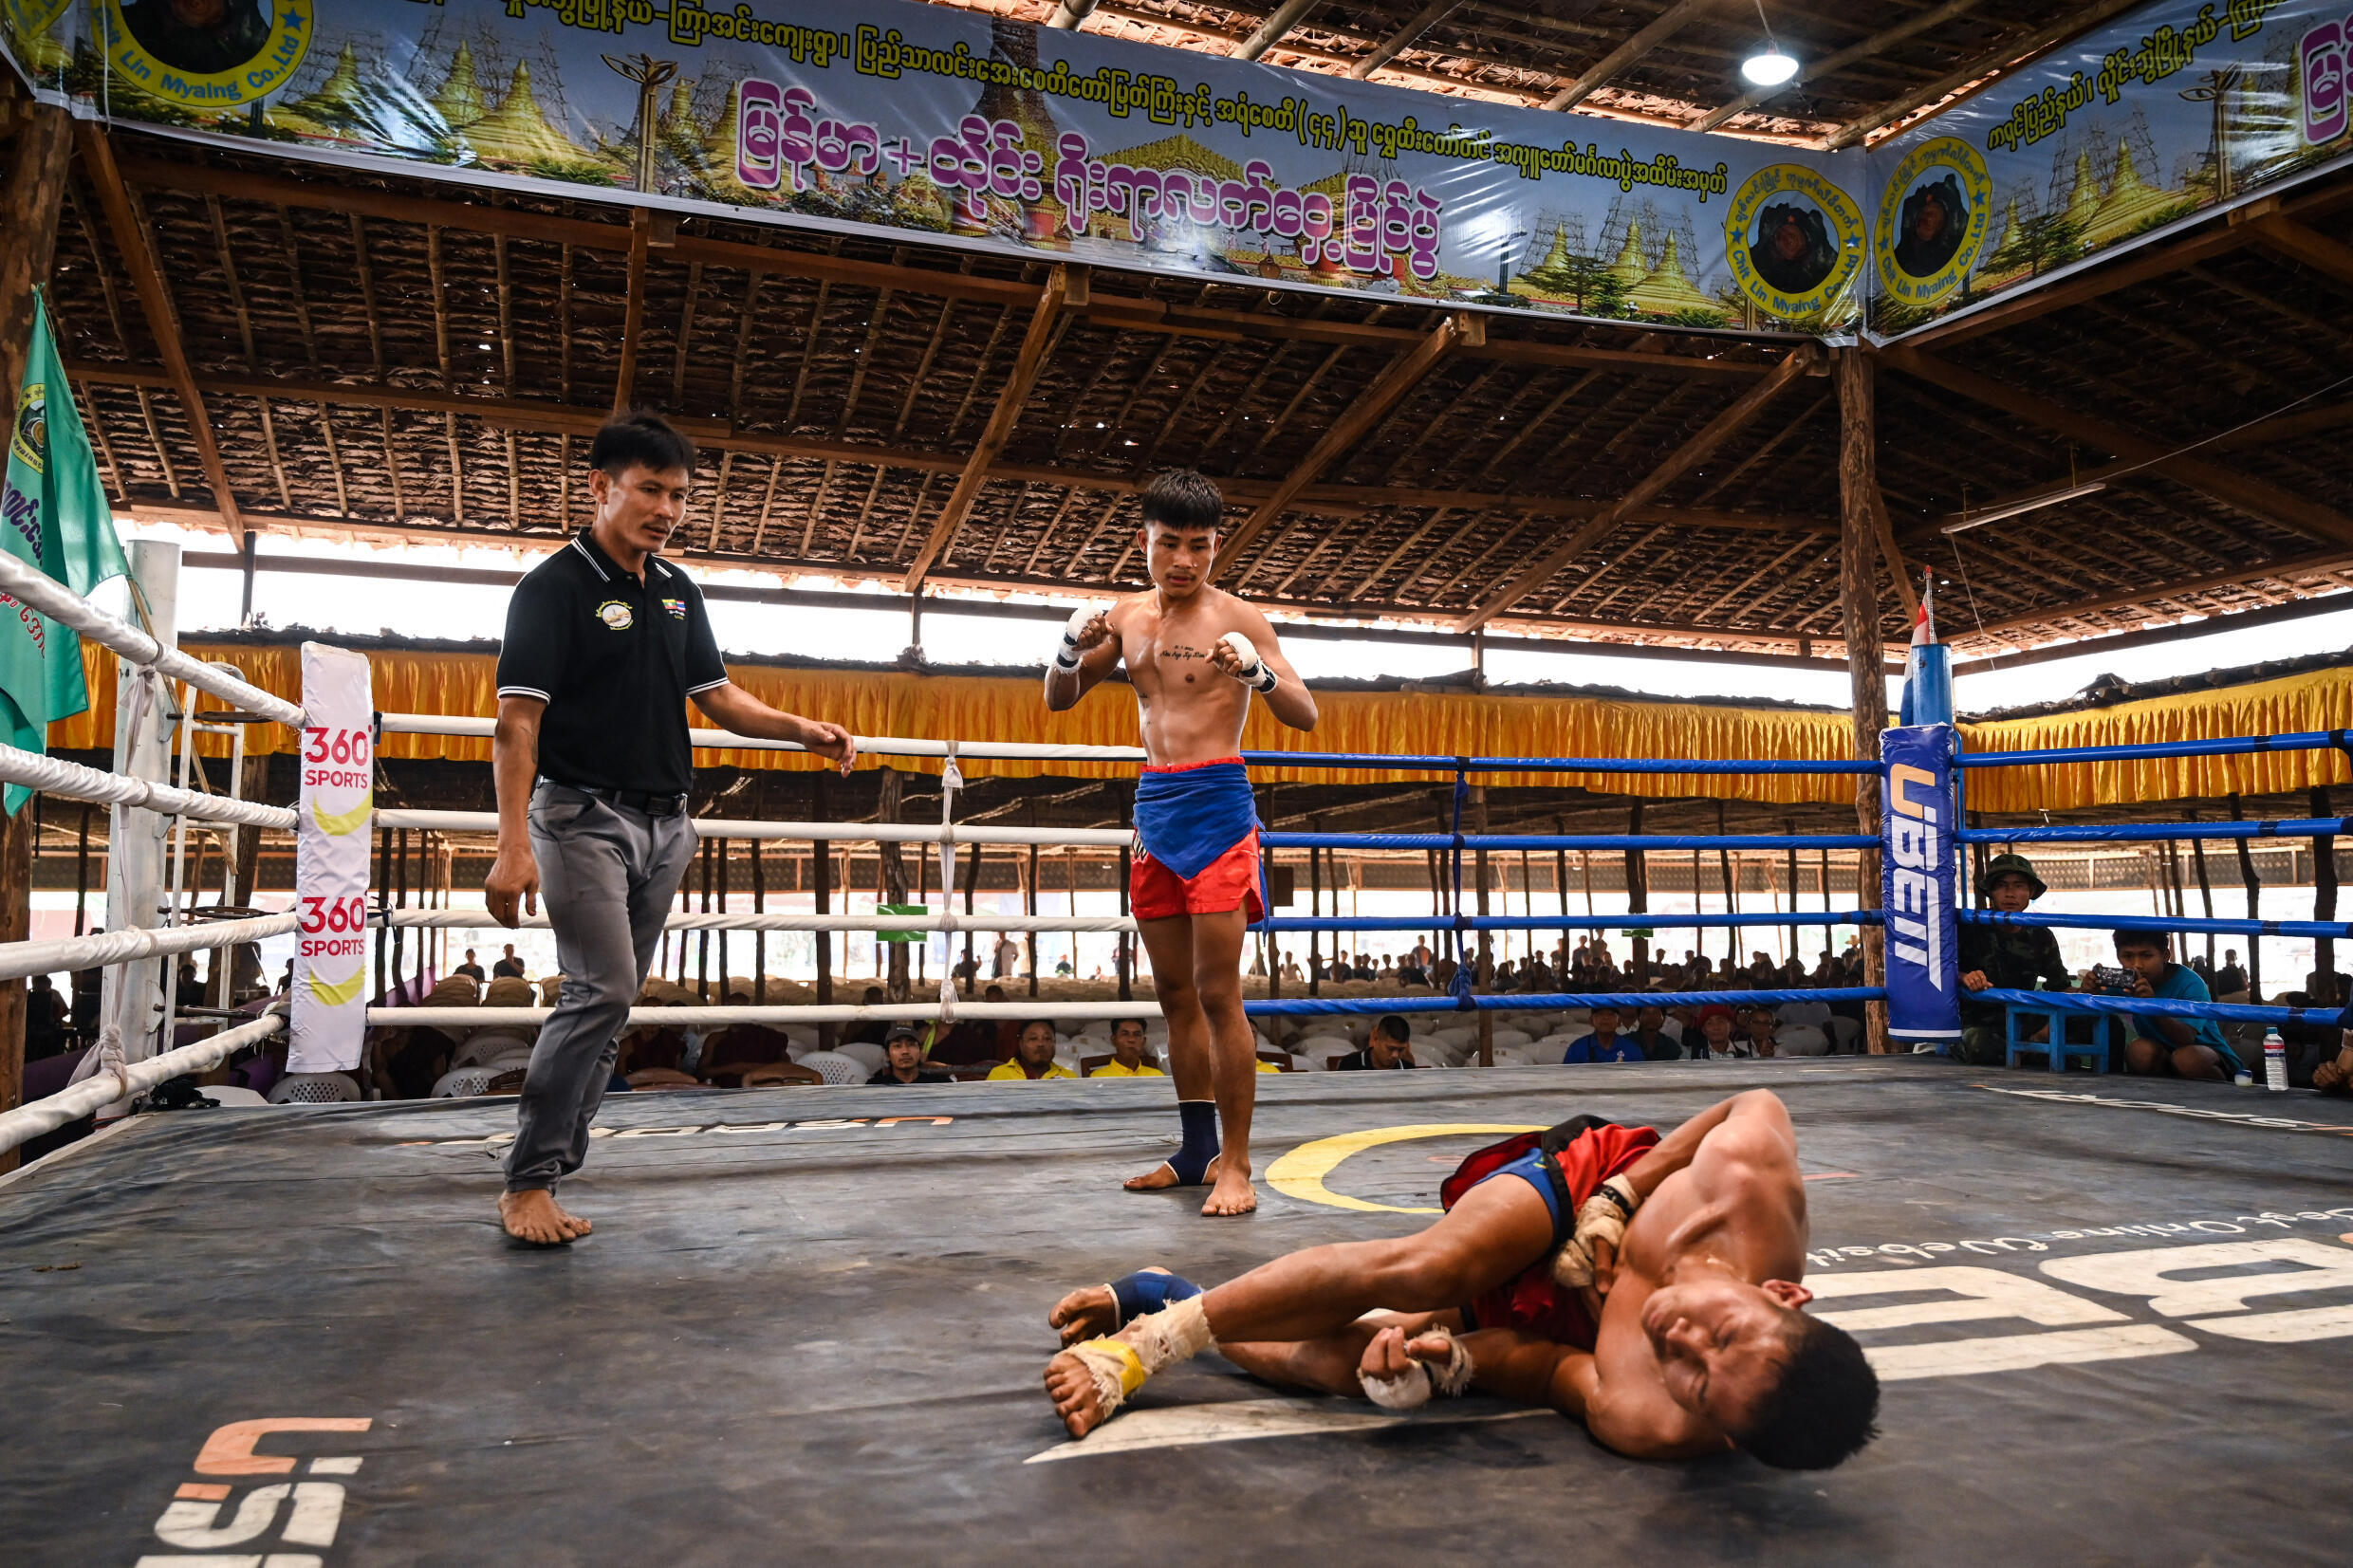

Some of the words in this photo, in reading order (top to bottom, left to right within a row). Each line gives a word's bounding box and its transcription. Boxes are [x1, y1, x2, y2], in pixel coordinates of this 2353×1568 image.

[120, 49, 151, 80] Lin
[160, 73, 242, 101] Myaing
[1732, 250, 1751, 281] Chit
[1750, 281, 1769, 302] Lin
[1772, 296, 1822, 315] Myaing
[1896, 279, 1912, 298] Lin
[1916, 268, 1958, 300] Myaing
[305, 769, 368, 789] SPORTS
[300, 939, 364, 956] SPORTS
[2051, 1220, 2247, 1240] Online
[1806, 1237, 2049, 1267] Websit
